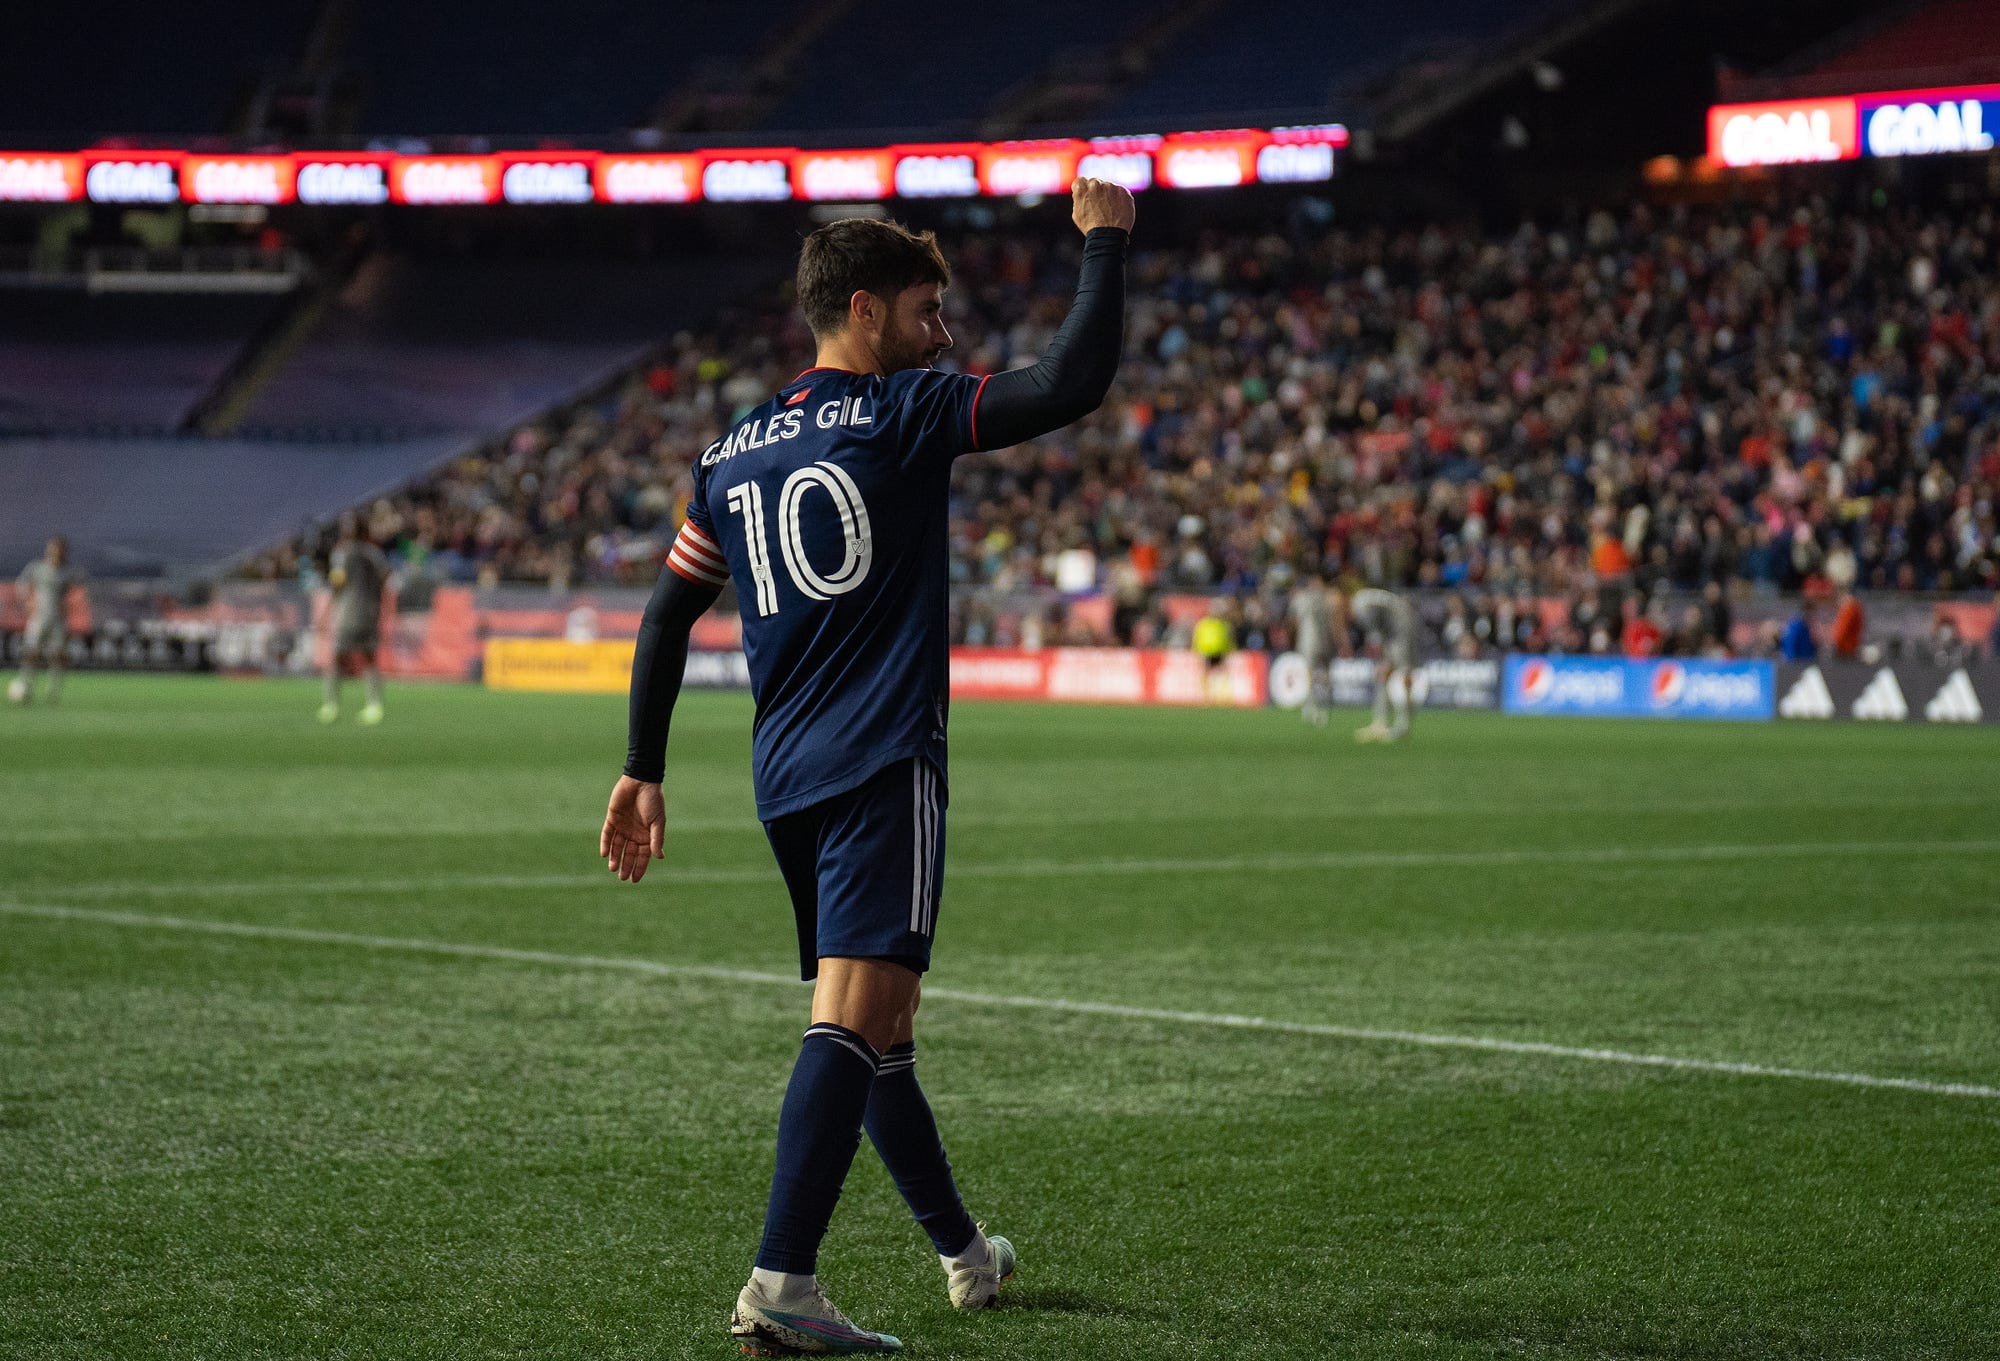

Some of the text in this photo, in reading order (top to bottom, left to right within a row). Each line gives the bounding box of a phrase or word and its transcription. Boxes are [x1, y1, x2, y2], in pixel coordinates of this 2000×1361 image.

[1722, 99, 1994, 167] GOAL GOAL
[701, 395, 873, 466] CARLES GIL
[727, 461, 873, 617] 10
